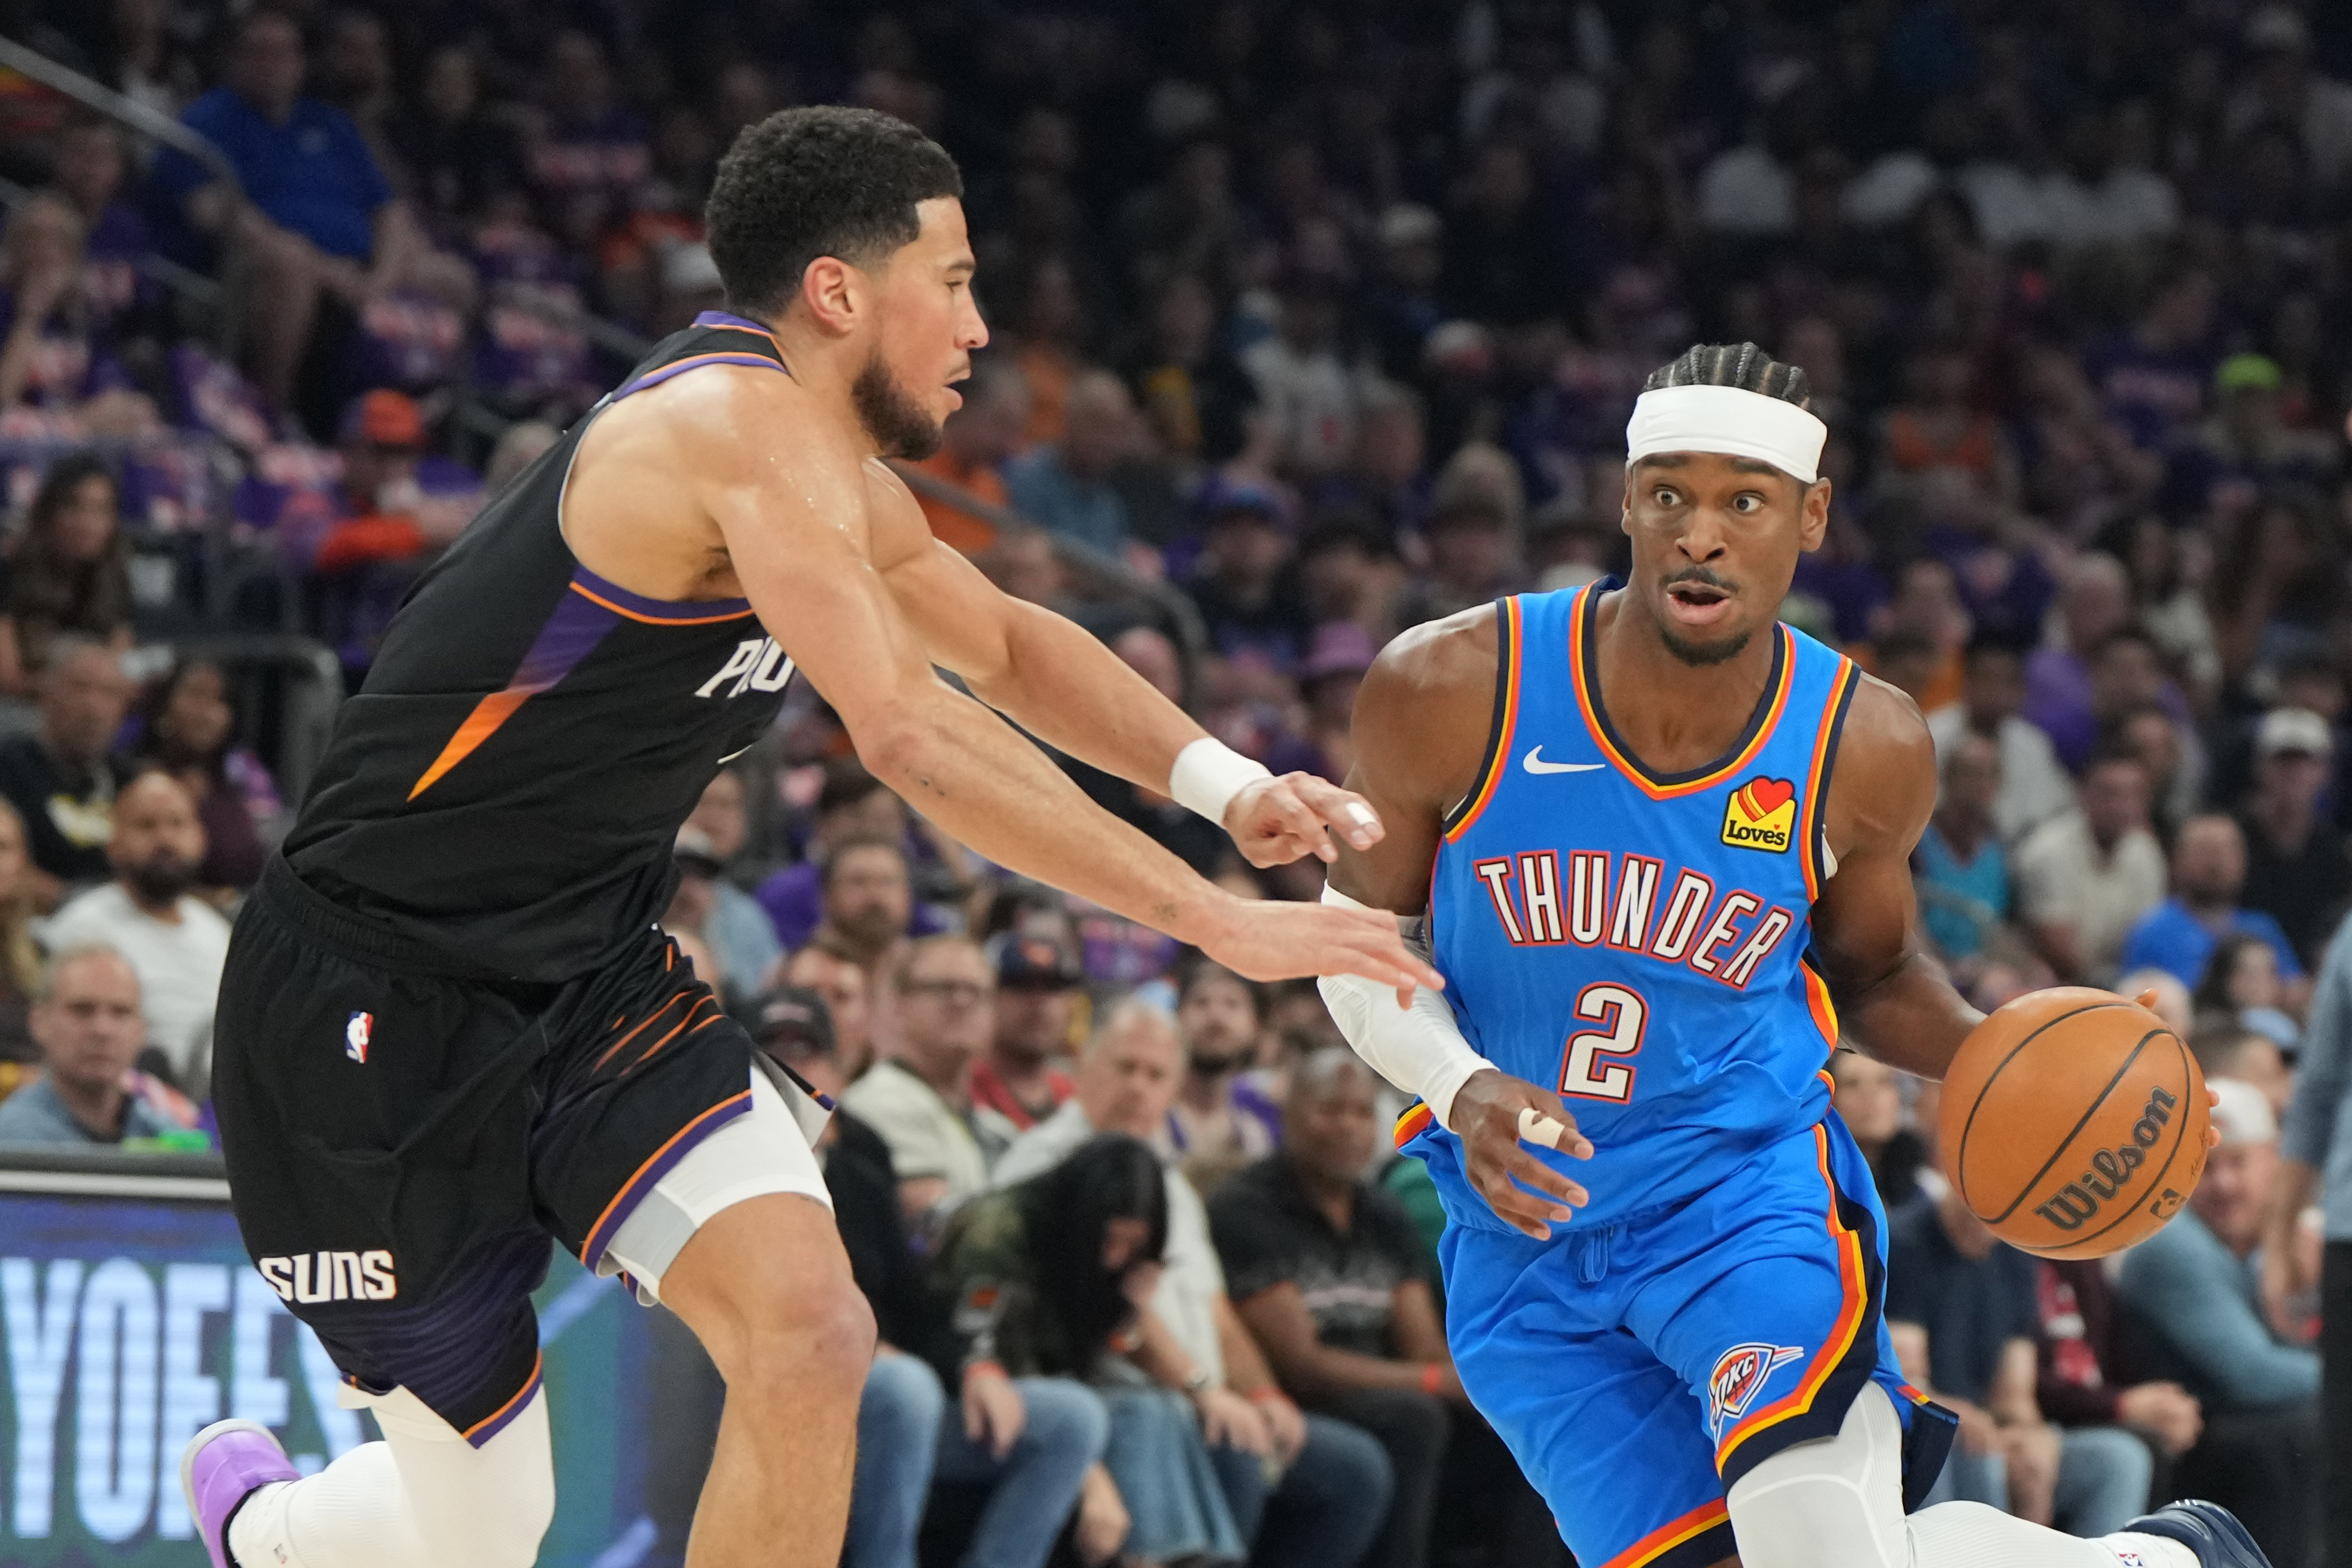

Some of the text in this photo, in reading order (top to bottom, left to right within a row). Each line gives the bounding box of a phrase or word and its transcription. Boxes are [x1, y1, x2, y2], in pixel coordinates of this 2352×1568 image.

[1473, 849, 1793, 991] THUNDER
[1557, 981, 1649, 1105] 2
[2033, 1085, 2177, 1231] Wilson
[258, 1250, 397, 1304] SUNS
[1715, 1353, 1755, 1421] OKC
